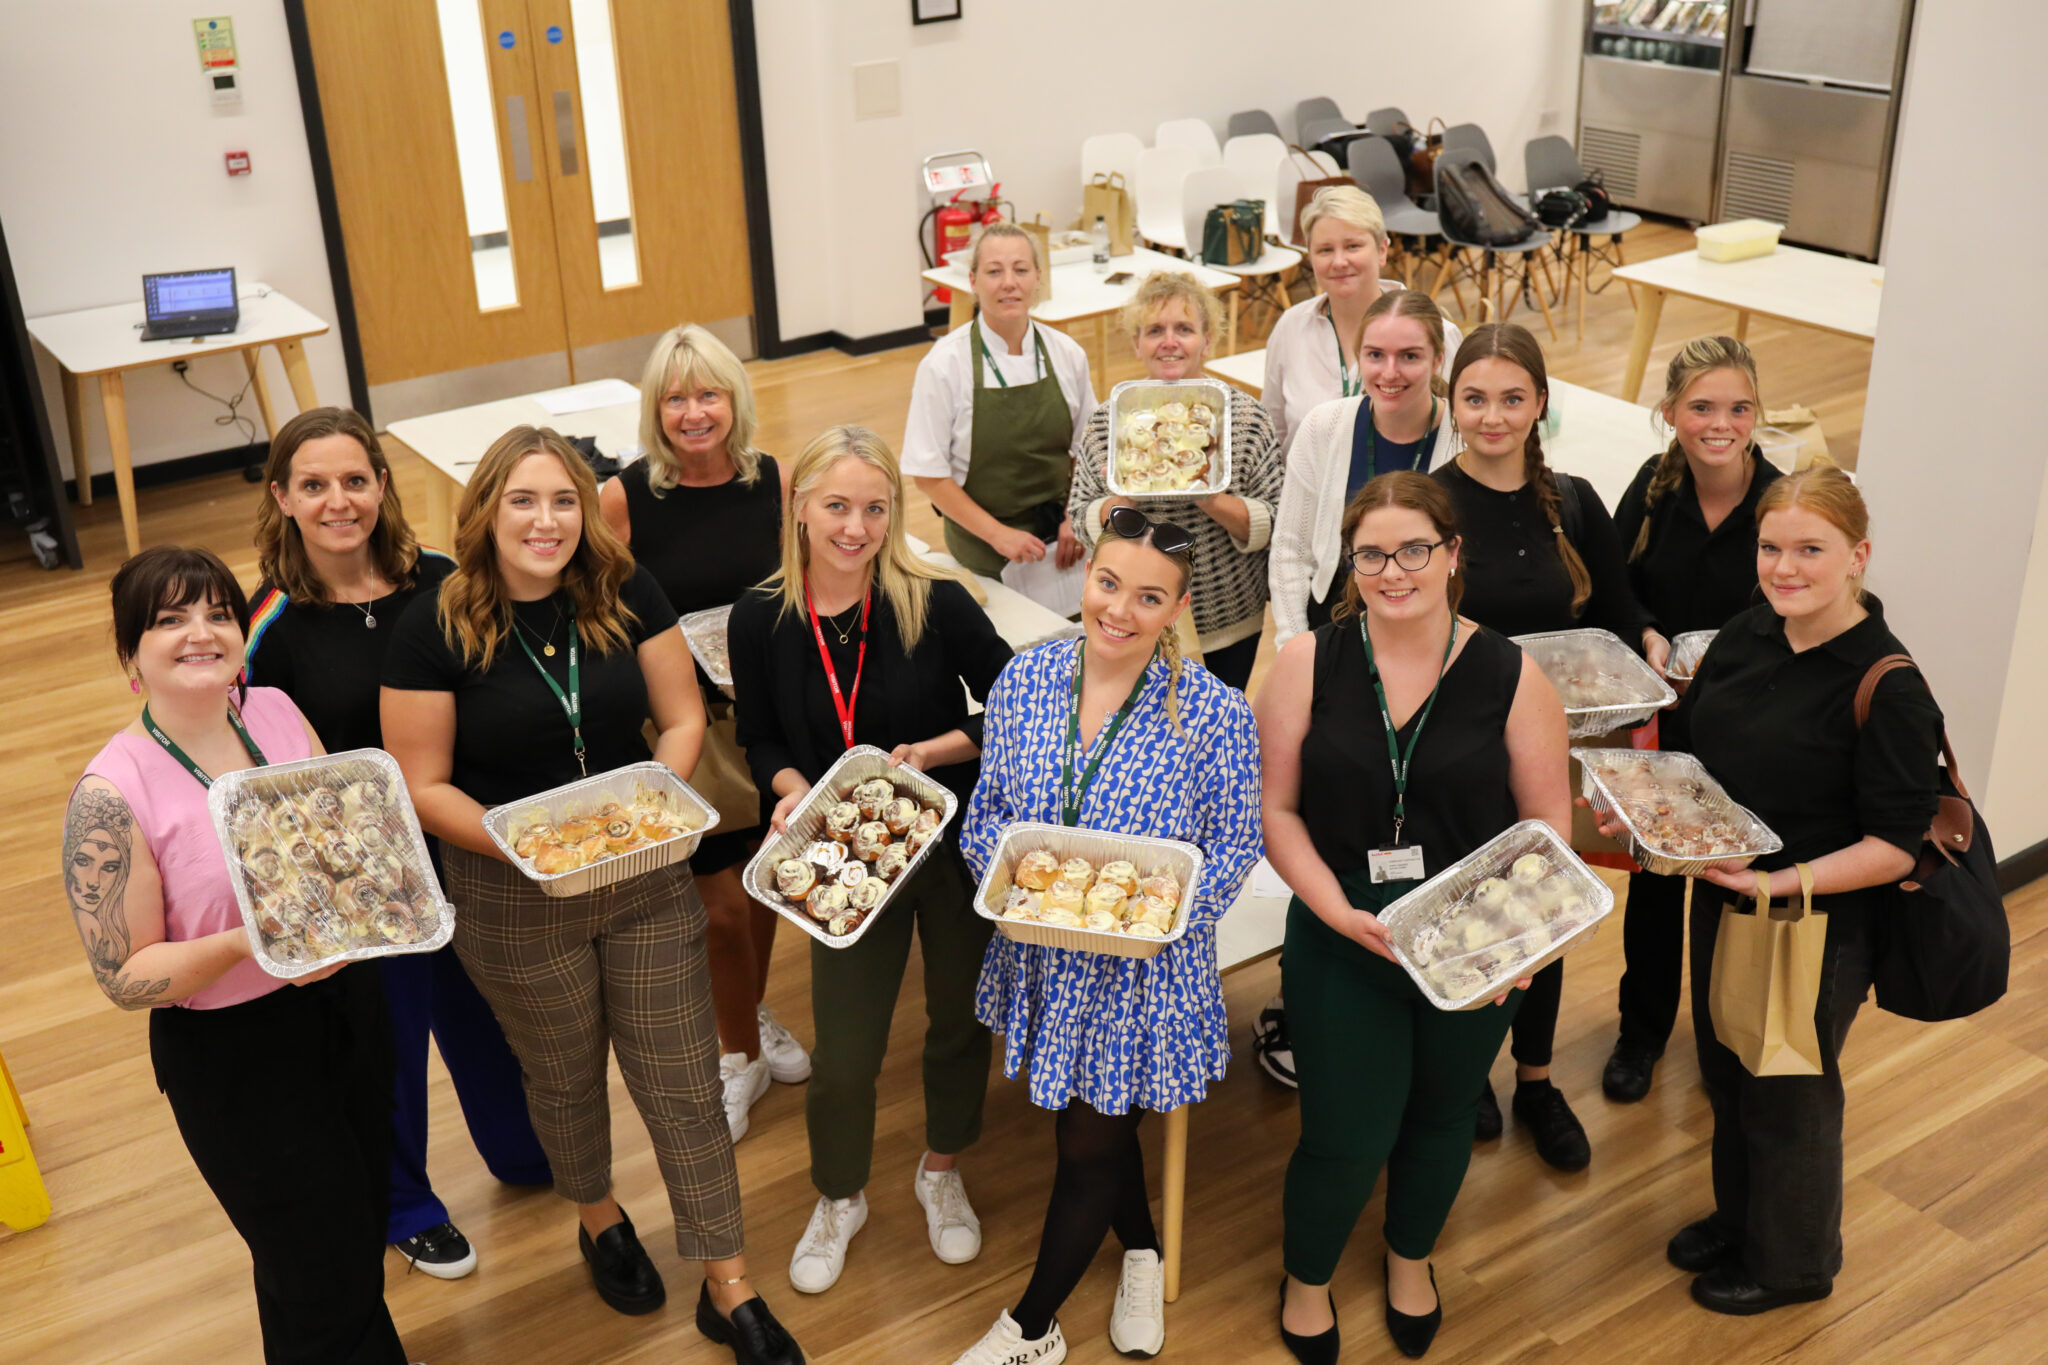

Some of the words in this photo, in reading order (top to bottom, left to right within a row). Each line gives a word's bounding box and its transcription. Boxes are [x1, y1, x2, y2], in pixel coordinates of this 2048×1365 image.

[830, 672, 840, 694] VISITOR
[1071, 693, 1079, 715] VISITOR
[1382, 709, 1391, 731] VISITOR
[152, 727, 171, 747] VISITOR
[1094, 740, 1109, 760] VISITOR
[1071, 789, 1083, 810] VISITOR
